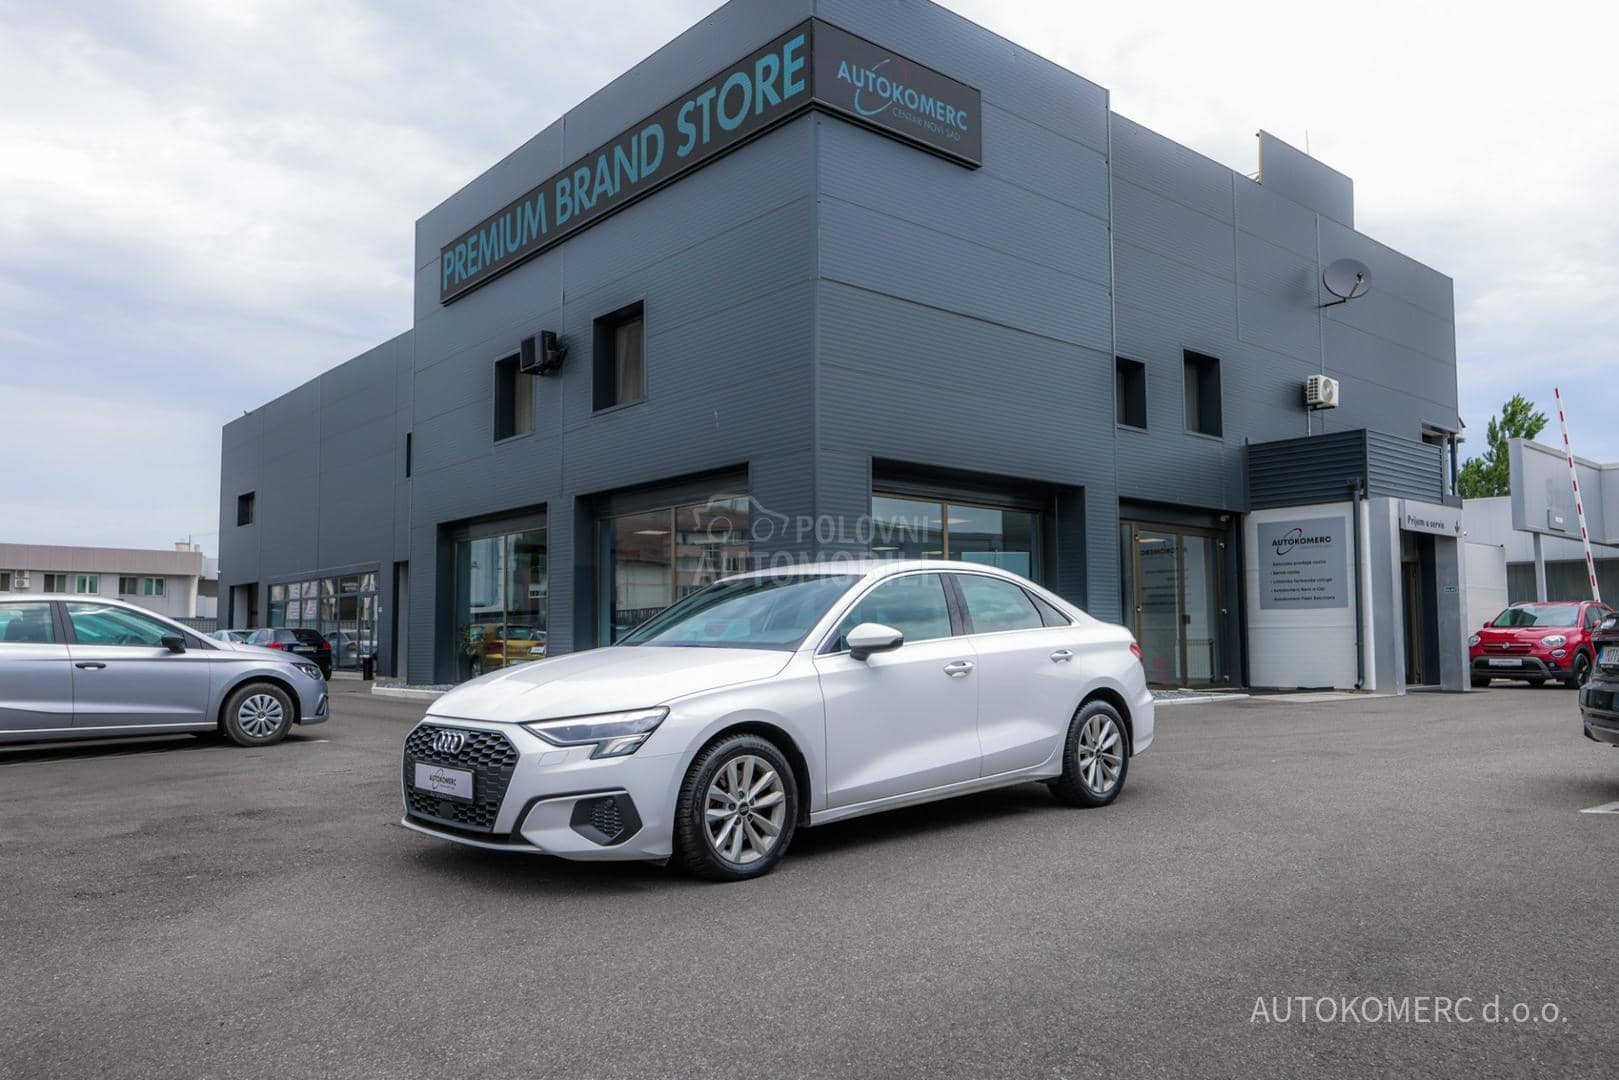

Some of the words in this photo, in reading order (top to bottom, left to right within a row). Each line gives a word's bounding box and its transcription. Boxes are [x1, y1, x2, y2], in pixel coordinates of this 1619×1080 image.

[837, 60, 968, 131] AUTOKOMERC
[442, 192, 548, 291] PREMIUM
[556, 124, 665, 225] BRAND
[677, 34, 806, 158] STORE
[1272, 536, 1332, 547] AUTOKOMERC
